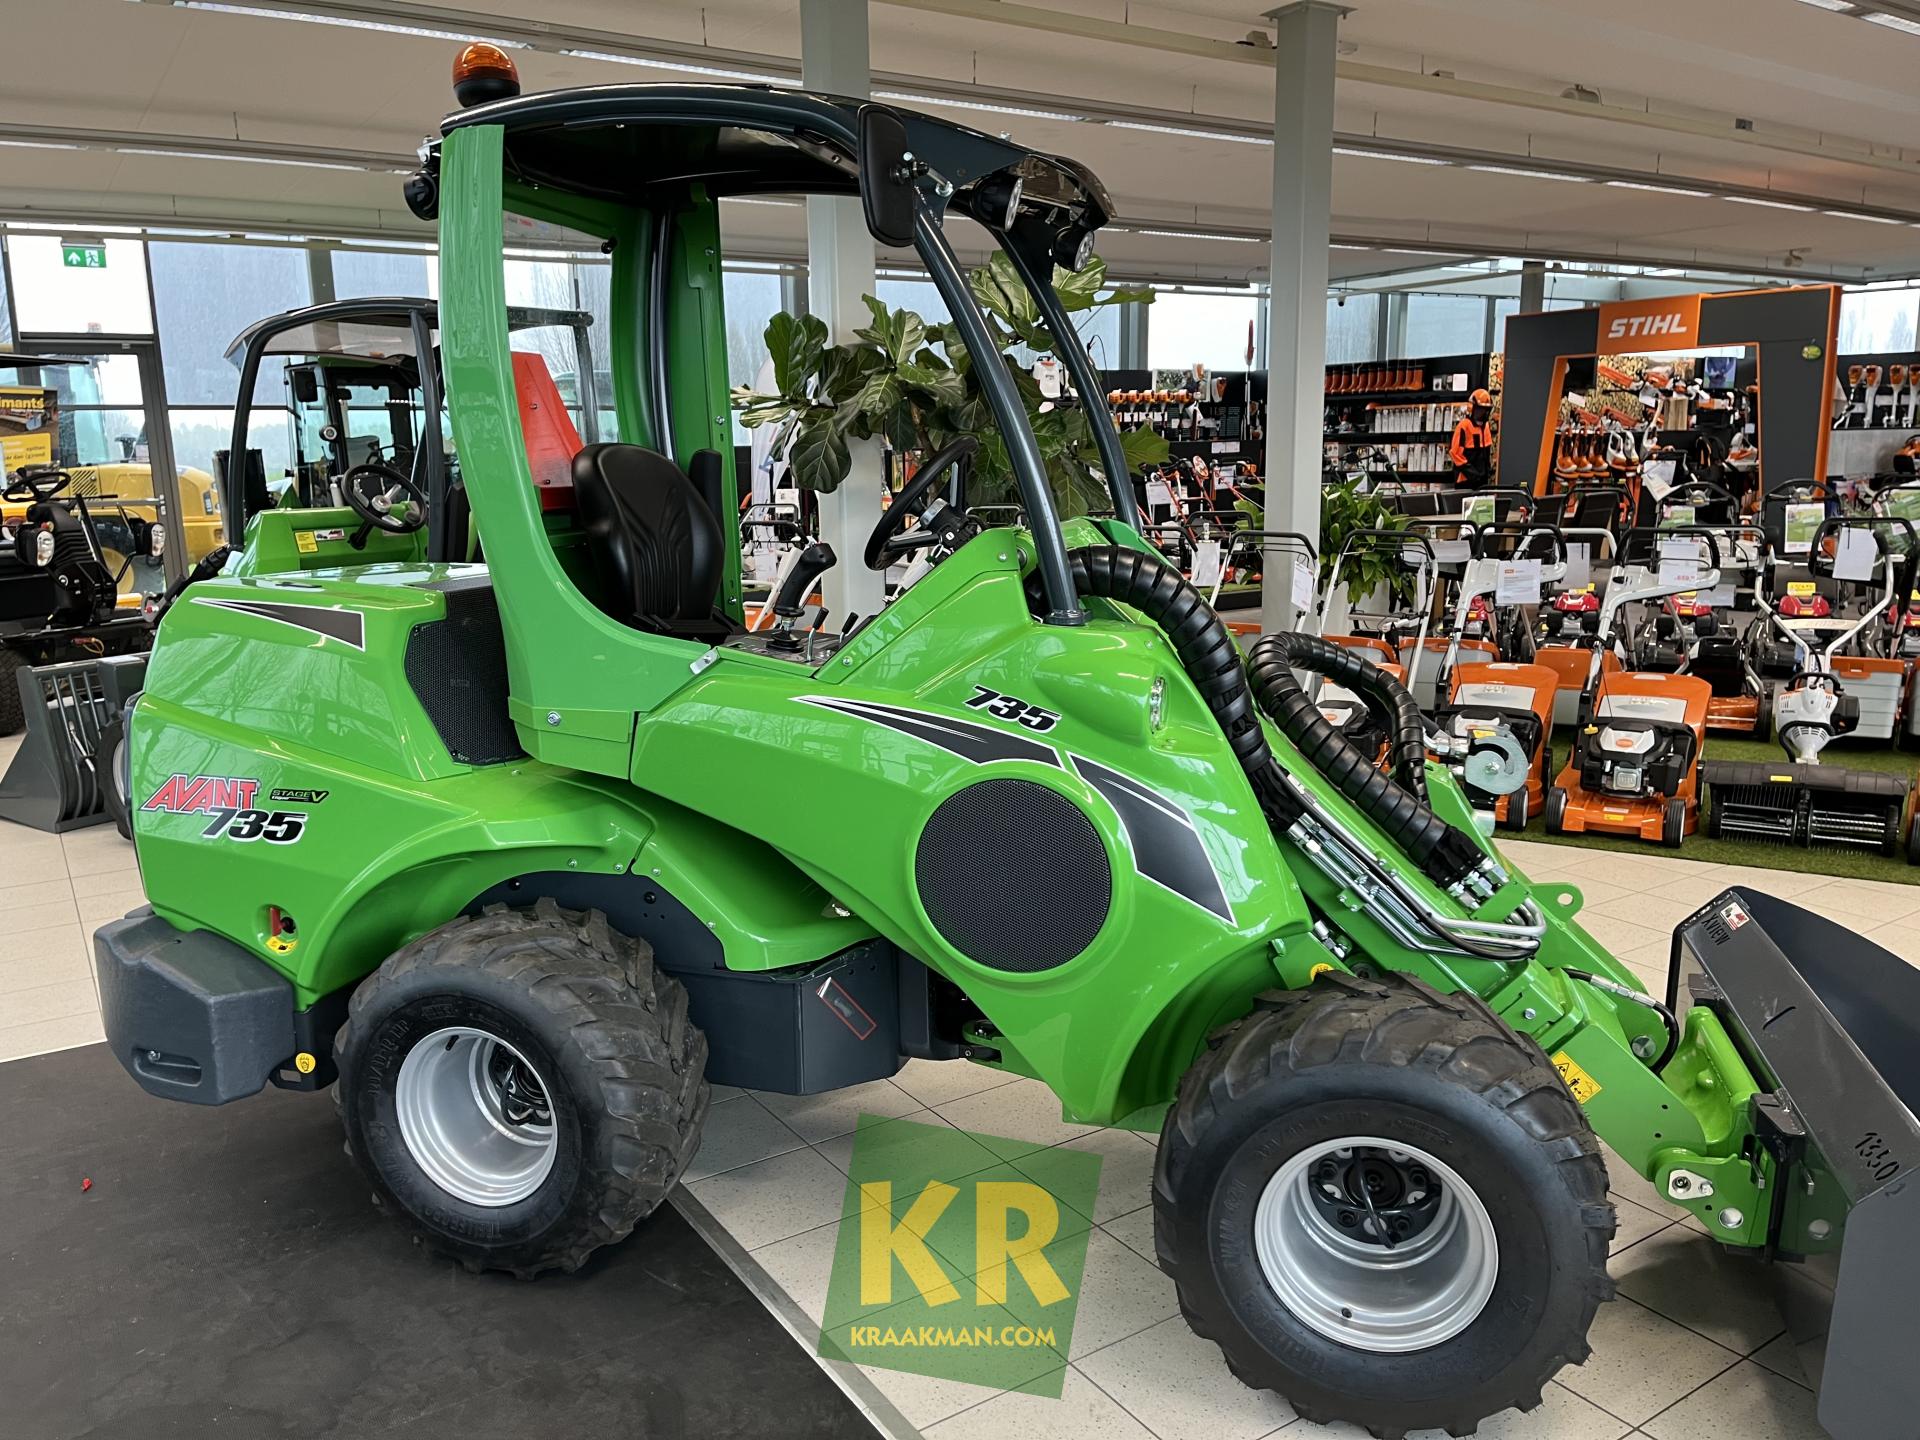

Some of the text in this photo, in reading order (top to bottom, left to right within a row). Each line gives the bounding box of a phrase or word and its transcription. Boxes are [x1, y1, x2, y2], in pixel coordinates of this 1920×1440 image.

[1607, 313, 1687, 339] STIHL
[962, 683, 1062, 733] 735
[139, 773, 261, 815] AVANT
[272, 790, 310, 798] STAGE
[201, 807, 308, 845] 735
